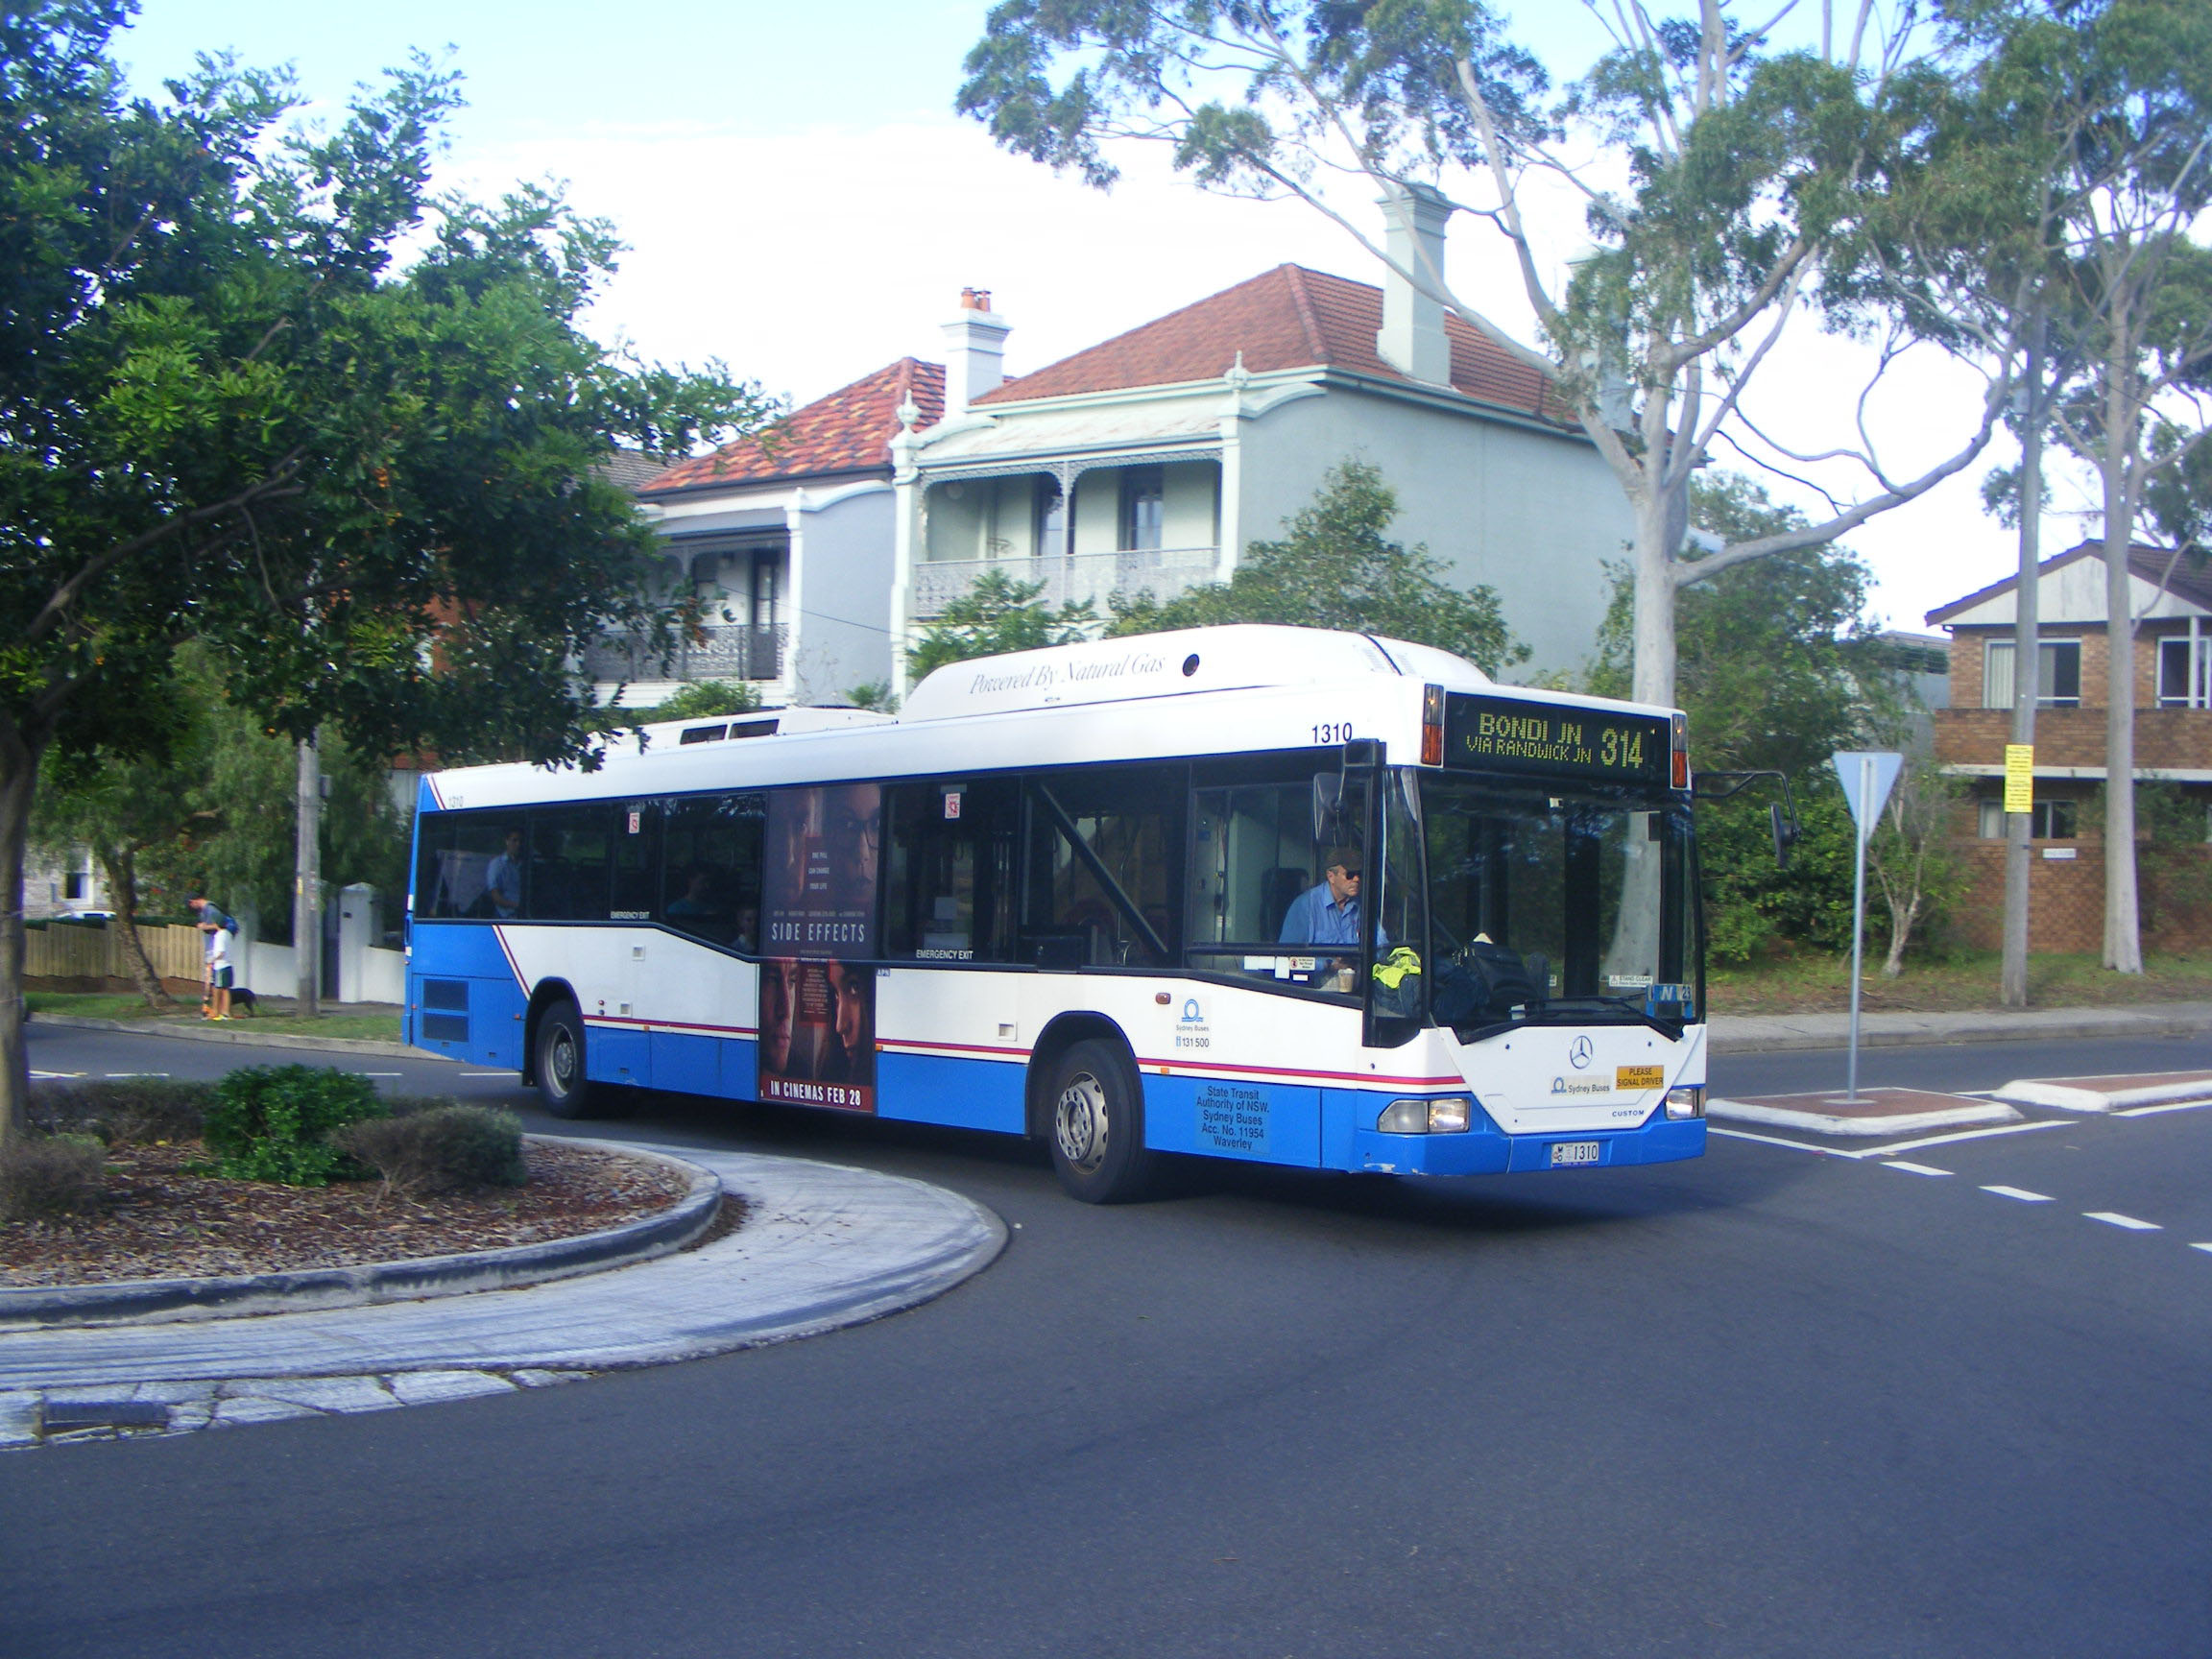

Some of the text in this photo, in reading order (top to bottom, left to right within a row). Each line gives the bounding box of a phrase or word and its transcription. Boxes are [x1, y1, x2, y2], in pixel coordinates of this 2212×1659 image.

[970, 653, 1166, 694] Powered By Natural Gas
[1311, 722, 1353, 744] 1310
[1479, 712, 1582, 745] BONDI JN
[1466, 734, 1592, 764] VIA RANDWICK JN
[1600, 728, 1644, 769] 314
[771, 922, 865, 943] SIDE EFFECTS
[916, 949, 974, 960] EMERGENCY EXIT
[1183, 1037, 1193, 1047] 131
[1195, 1038, 1210, 1048] 500
[1628, 1068, 1652, 1076] PLEASE
[1568, 1083, 1610, 1094] Sydney Buses
[1617, 1076, 1664, 1087] SIGNAL DRIVER
[770, 1080, 781, 1096] IN
[783, 1081, 824, 1102] CINEMAS
[827, 1087, 846, 1104] FEB
[849, 1089, 861, 1106] 28
[1207, 1085, 1260, 1101] State Transit
[1196, 1096, 1270, 1114] Authority of NSW.
[1612, 1109, 1645, 1118] CUSTOM
[1203, 1110, 1263, 1126] Sydney Buses
[1201, 1123, 1264, 1140] Acc. No. 11954
[1214, 1136, 1253, 1151] Waverley
[1574, 1144, 1598, 1161] 1310
